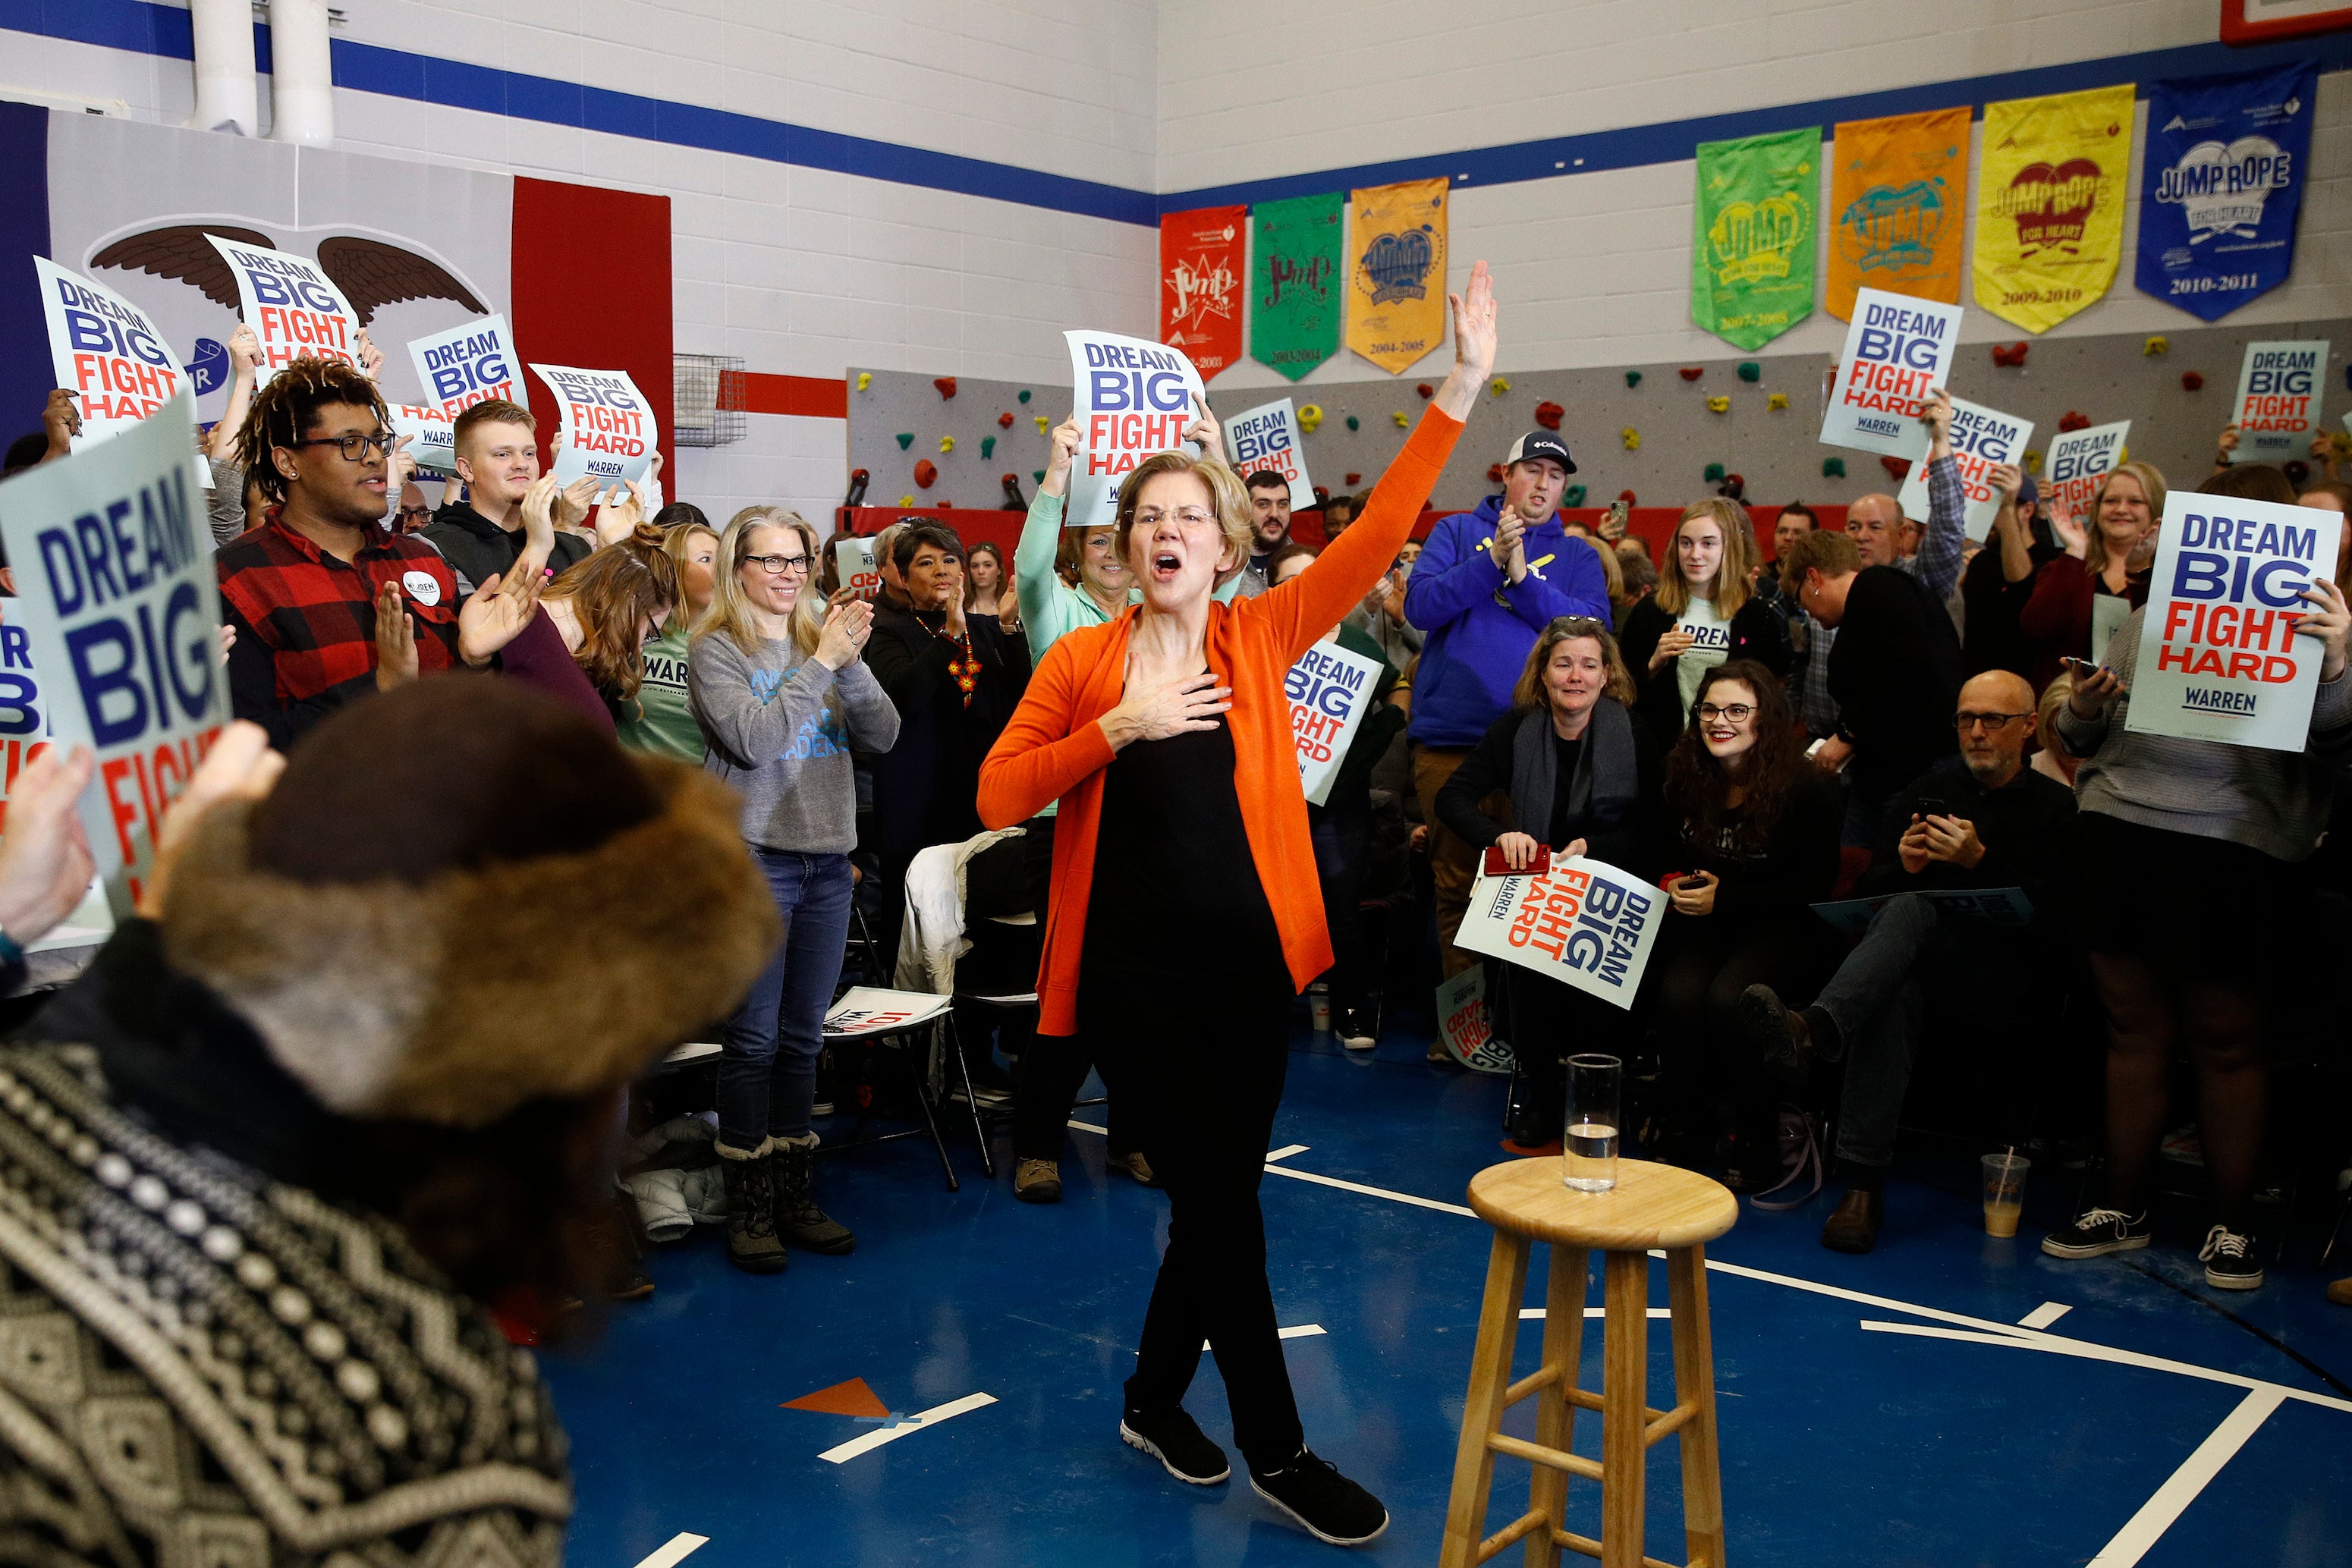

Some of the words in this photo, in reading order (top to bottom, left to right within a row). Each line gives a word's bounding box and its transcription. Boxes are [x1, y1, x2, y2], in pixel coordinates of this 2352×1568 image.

[1991, 182, 2052, 218] JUMP
[2052, 174, 2110, 215] ROPE
[2157, 164, 2225, 203] JUMP
[2227, 155, 2293, 193] ROPE
[1721, 208, 1793, 262] JUMP
[1859, 206, 1938, 251] JUMP
[229, 248, 322, 284] DREAM
[2169, 272, 2259, 295] 2010-2011
[56, 278, 152, 335] DREAM
[245, 269, 342, 314] BIG
[2001, 288, 2082, 305] 2009-2010
[64, 309, 171, 369] BIG
[259, 306, 347, 349] FIGHT
[1865, 303, 1946, 339] DREAM
[423, 329, 500, 371] DREAM
[1085, 343, 1181, 372] DREAM
[1857, 328, 1939, 372] BIG
[2253, 351, 2316, 369] DREAM
[74, 354, 177, 401] FIGHT
[432, 354, 510, 400] BIG
[547, 371, 625, 391] DREAM
[1090, 370, 1189, 411] BIG
[1849, 360, 1934, 399] FIGHT
[2248, 372, 2312, 394] BIG
[80, 394, 167, 420] HAR
[401, 405, 460, 423] HAR
[558, 382, 640, 410] BIG
[1844, 388, 1926, 418] HARD
[2243, 396, 2311, 417] FIGHT
[423, 429, 454, 445] WARR
[570, 403, 643, 437] FIGHT
[1090, 414, 1189, 449] FIGHT
[1234, 410, 1286, 441] DREAM
[1858, 416, 1901, 434] WARREN
[2240, 418, 2309, 432] HARD
[574, 430, 645, 457] HARD
[1237, 428, 1291, 462] BIG
[2058, 432, 2117, 457] DREAM
[587, 460, 624, 475] WARREN
[2052, 451, 2110, 482] BIG
[36, 464, 196, 617] DREAM
[2180, 514, 2317, 561] DREAM
[2171, 551, 2312, 608] BIG
[2163, 602, 2307, 653] FIGHT
[64, 580, 213, 749] BIG
[2158, 645, 2297, 683] HARD
[1284, 668, 1354, 721] BIG
[2186, 687, 2256, 712] WARREN
[1288, 701, 1344, 745] GHT
[1295, 737, 1332, 762] RD
[1492, 877, 1521, 920] WARREN
[1531, 868, 1591, 961] FIGHT
[1562, 876, 1627, 974] BIG
[1598, 891, 1651, 988] DREAM
[1453, 1017, 1491, 1059] FIGHT
[1468, 1037, 1514, 1069] BIG
